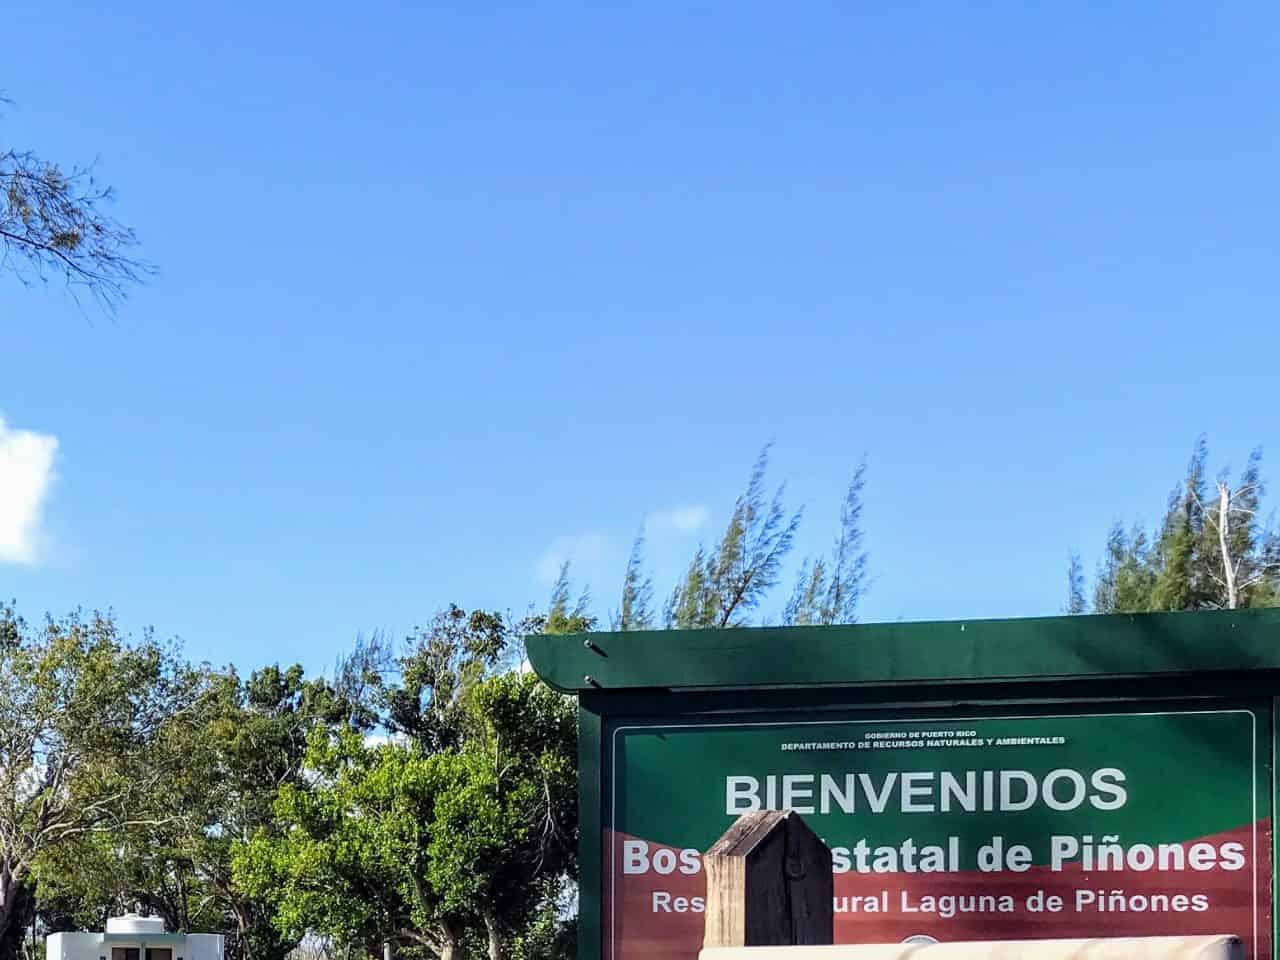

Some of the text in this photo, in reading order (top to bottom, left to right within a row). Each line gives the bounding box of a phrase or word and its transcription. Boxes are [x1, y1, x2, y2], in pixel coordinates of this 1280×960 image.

[781, 742, 856, 751] DEPARTAMENTO
[873, 740, 924, 748] RECURSOS
[926, 738, 984, 747] NATURALES
[995, 736, 1065, 745] AMBIENTALES
[726, 768, 1128, 815] BIENVENIDOS
[623, 834, 1246, 875] Bos statal de Piñones
[832, 889, 1209, 918] ural Laguna de Piñones
